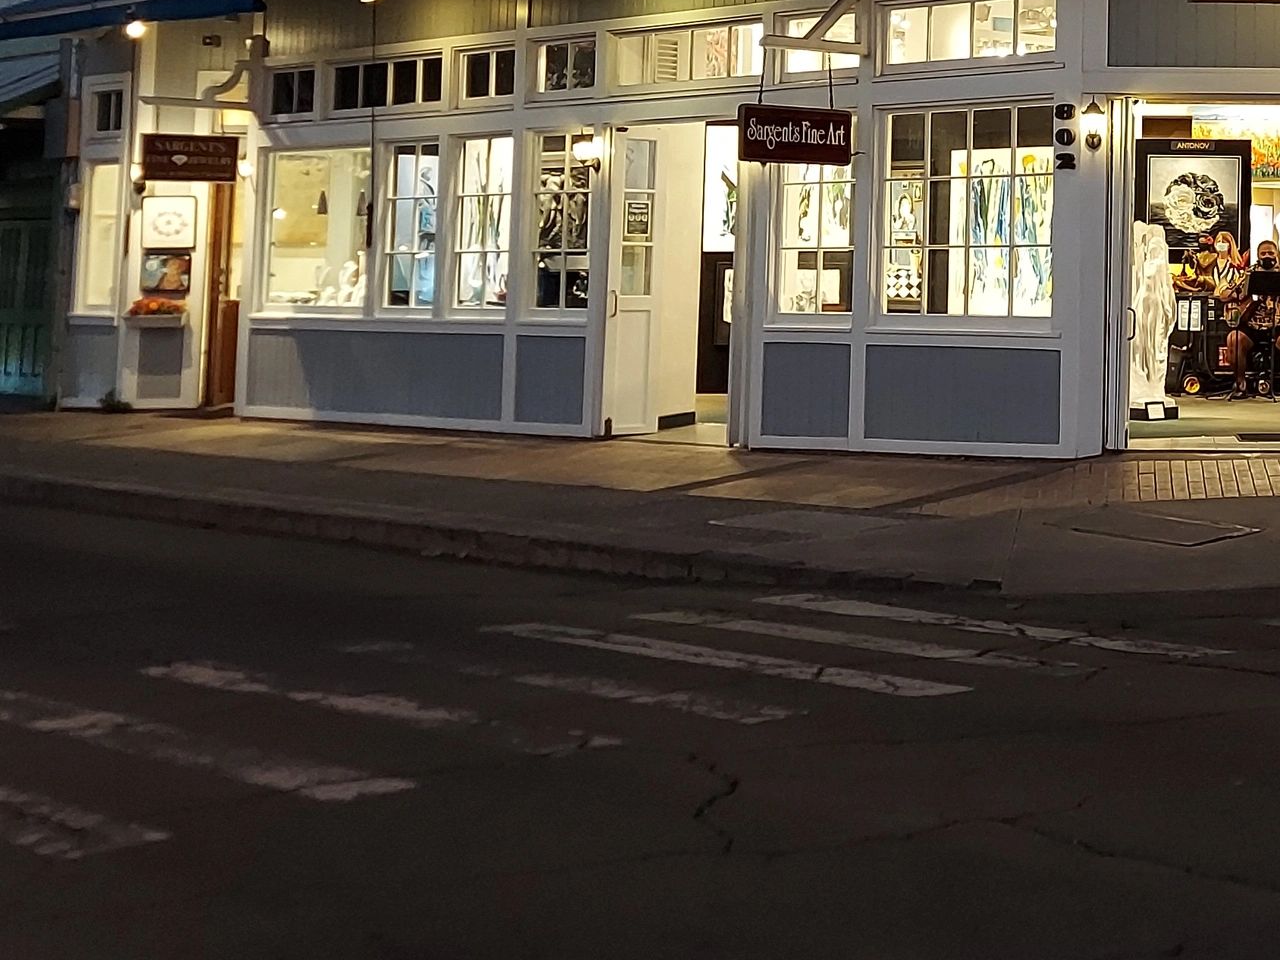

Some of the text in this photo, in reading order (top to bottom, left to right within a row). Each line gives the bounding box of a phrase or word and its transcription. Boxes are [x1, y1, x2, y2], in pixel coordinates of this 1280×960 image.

[747, 118, 846, 149] Sargent's Fine Art
